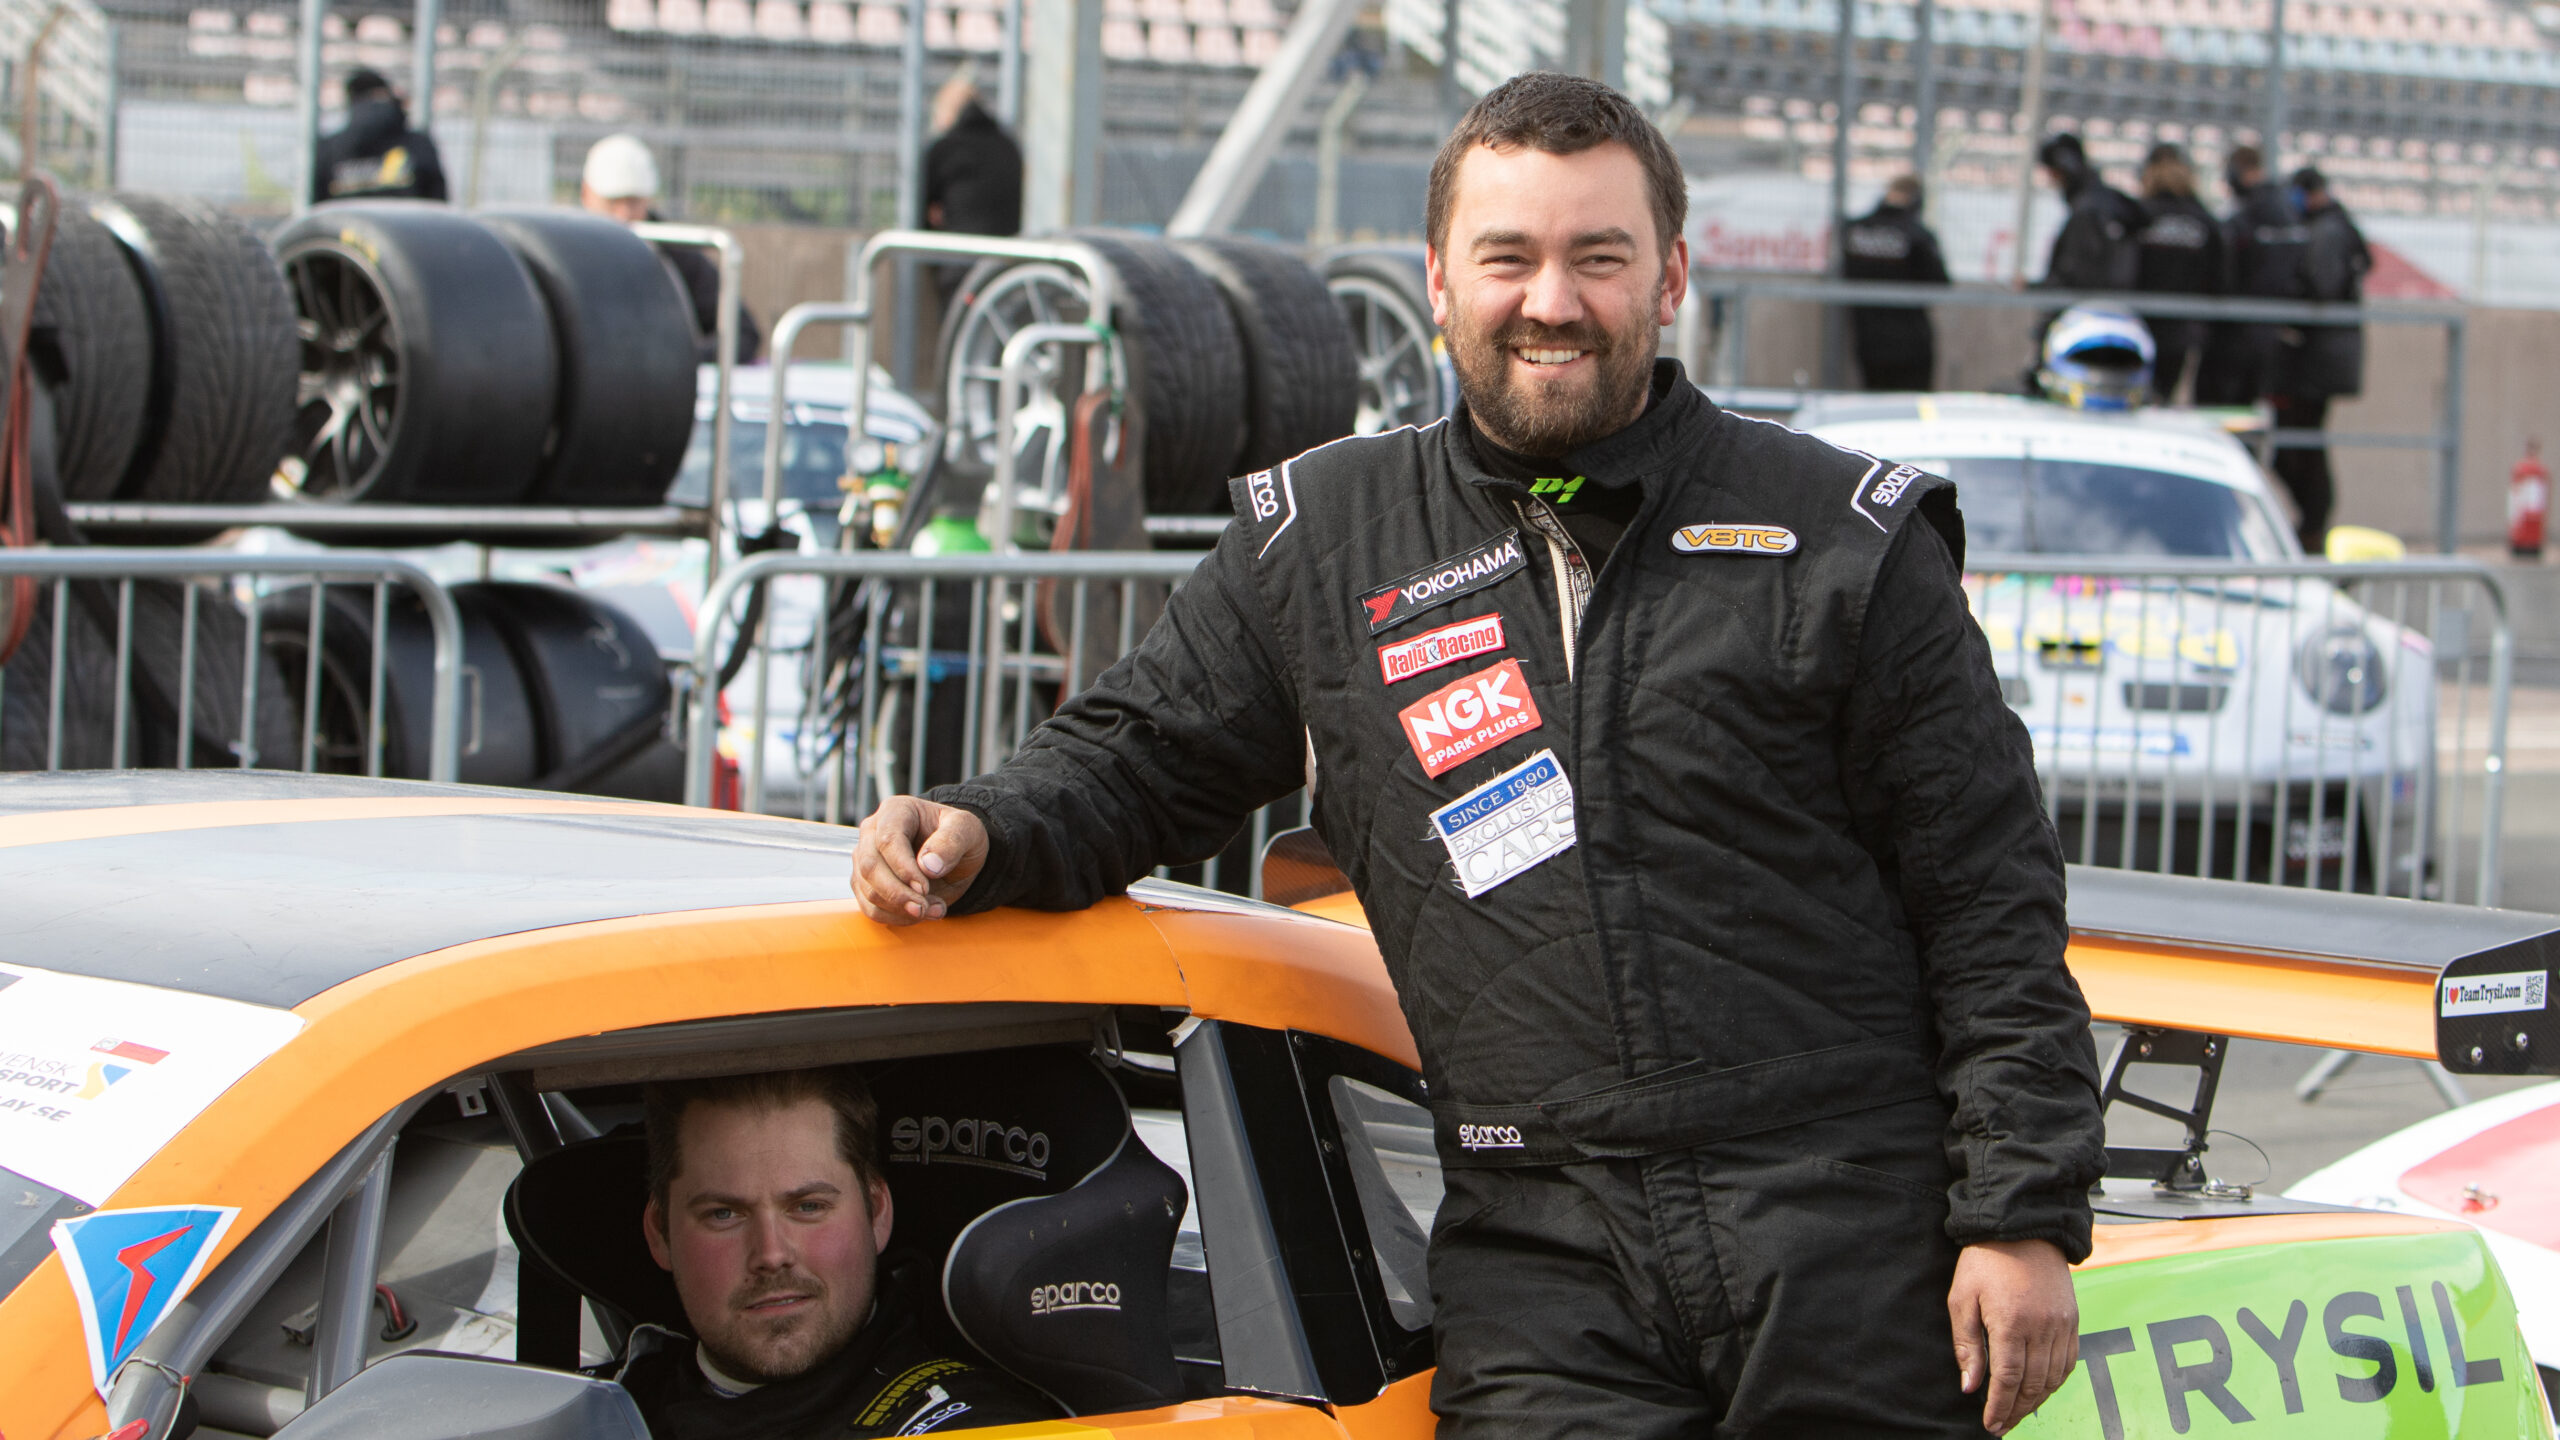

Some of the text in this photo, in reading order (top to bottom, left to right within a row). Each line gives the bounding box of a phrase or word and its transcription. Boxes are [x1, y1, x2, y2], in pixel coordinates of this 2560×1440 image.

[1401, 542, 1519, 605] YOKOHAMA
[1409, 670, 1521, 753] NGK
[1427, 711, 1529, 767] SPARK PLUGS
[1449, 766, 1549, 829] SINCE 1990
[1451, 781, 1569, 856] EXCLUSIVE
[1463, 803, 1576, 885] CARS
[891, 1116, 1050, 1170] sparco
[1459, 1124, 1522, 1151] sparco
[1031, 1282, 1121, 1315] sparco
[2078, 1281, 2504, 1440] TRYSIL
